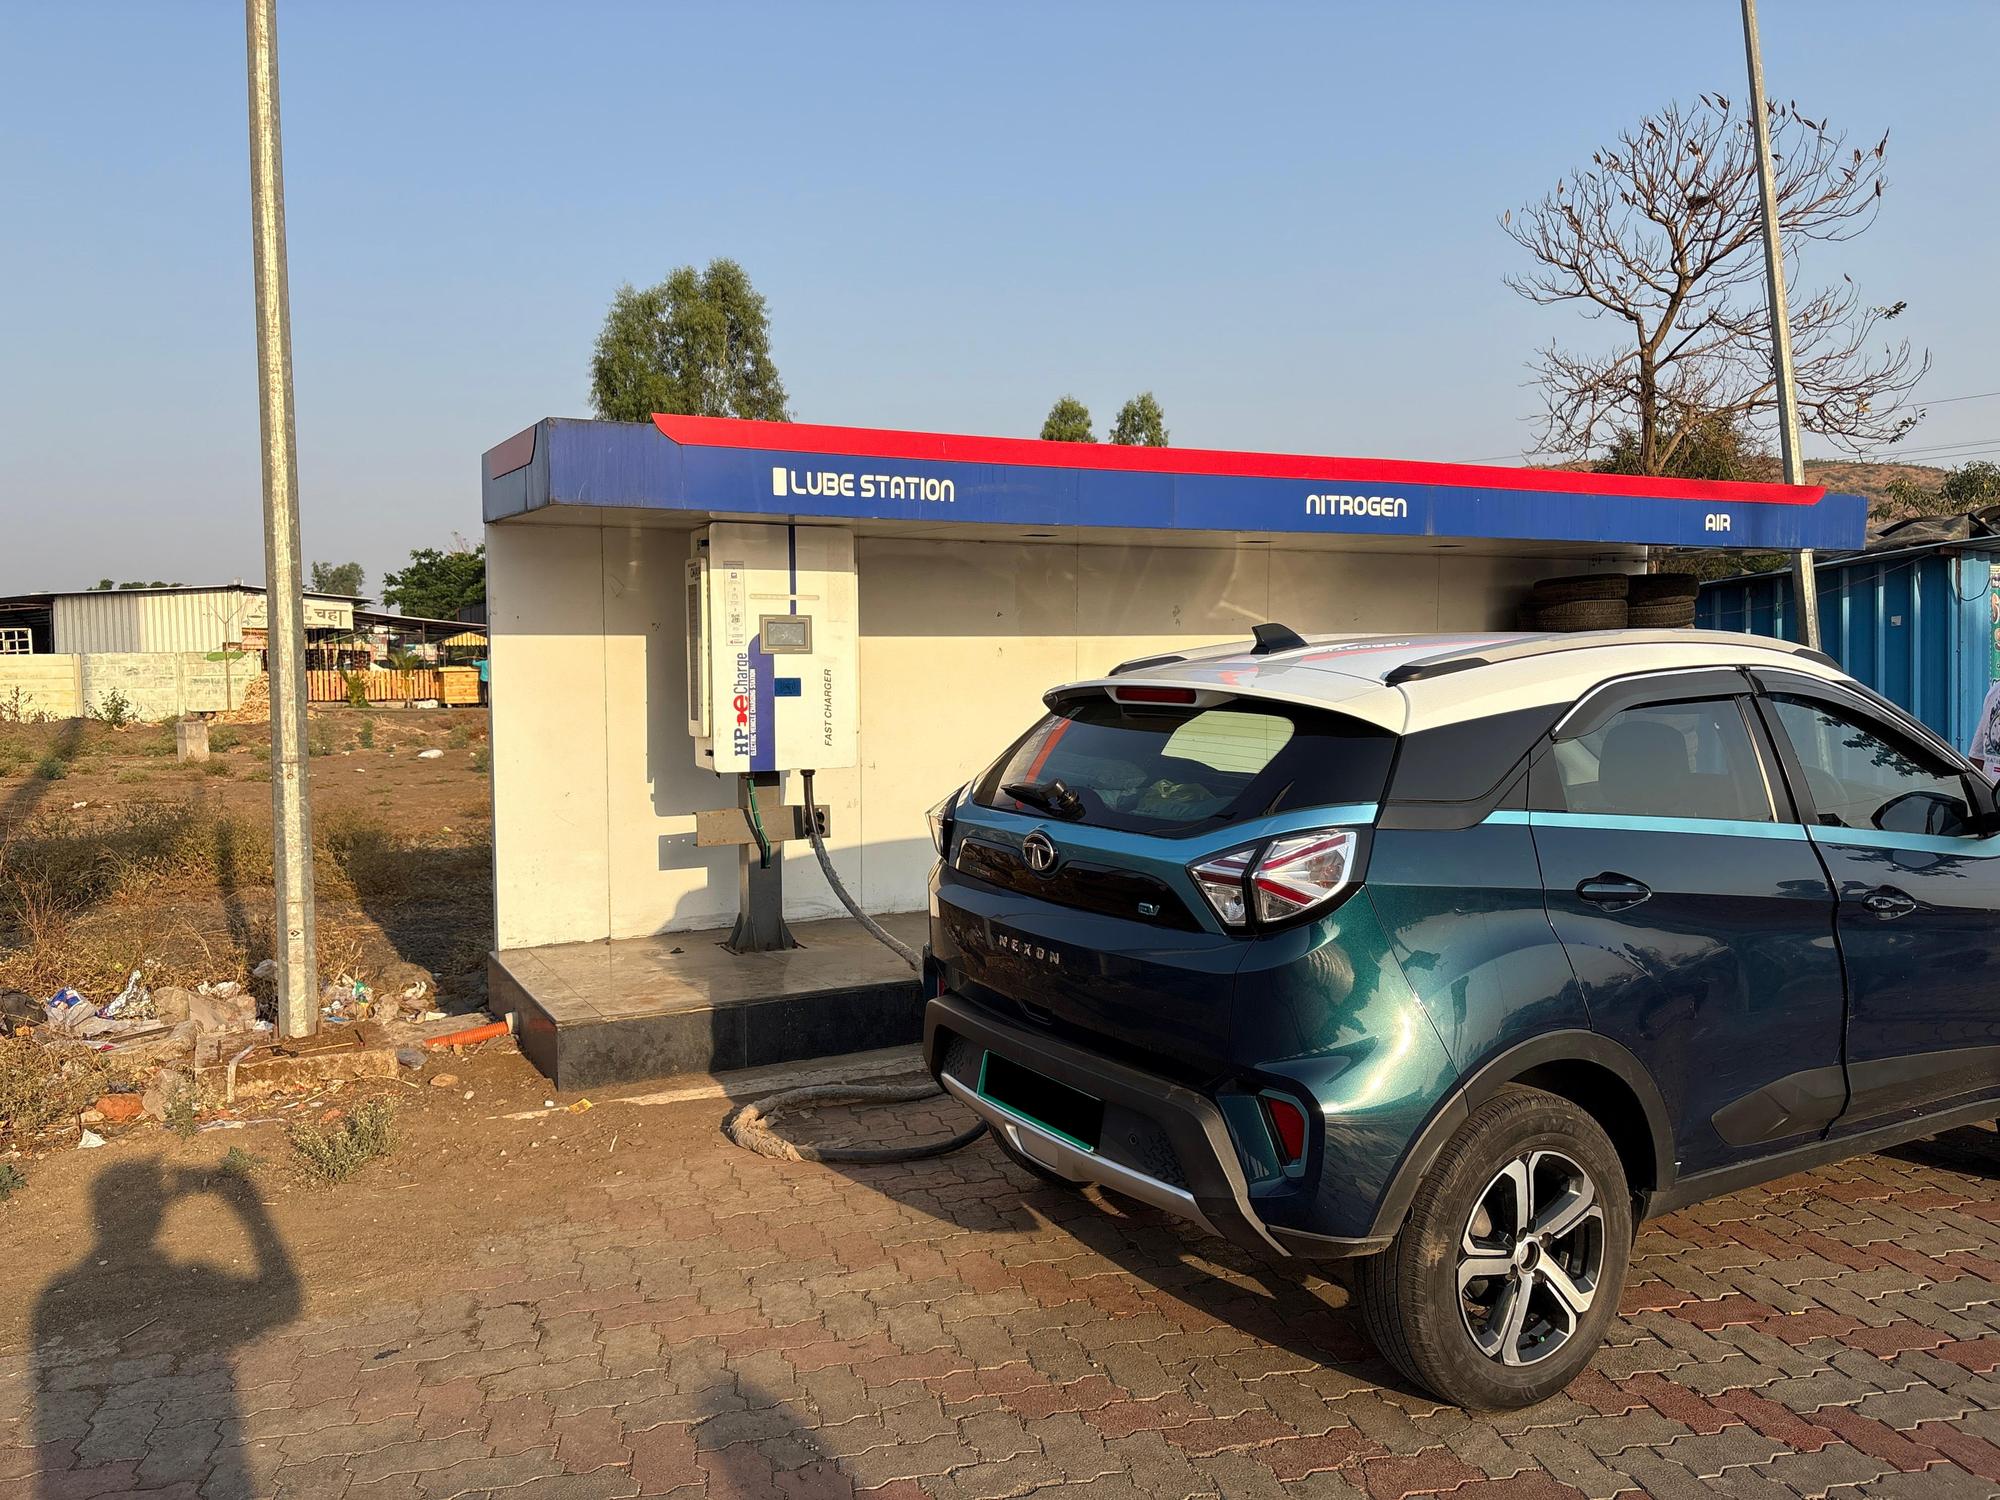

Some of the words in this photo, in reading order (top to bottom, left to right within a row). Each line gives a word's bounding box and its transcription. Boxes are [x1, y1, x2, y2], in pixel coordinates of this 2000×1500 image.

[790, 470, 855, 497] LUBE
[860, 474, 955, 502] STATION
[1305, 494, 1408, 518] NITROGEN
[1705, 513, 1731, 532] AIR
[823, 668, 833, 719] CHARGER
[733, 727, 749, 757] HP
[824, 720, 833, 747] FAST
[999, 934, 1060, 966] NEXON
